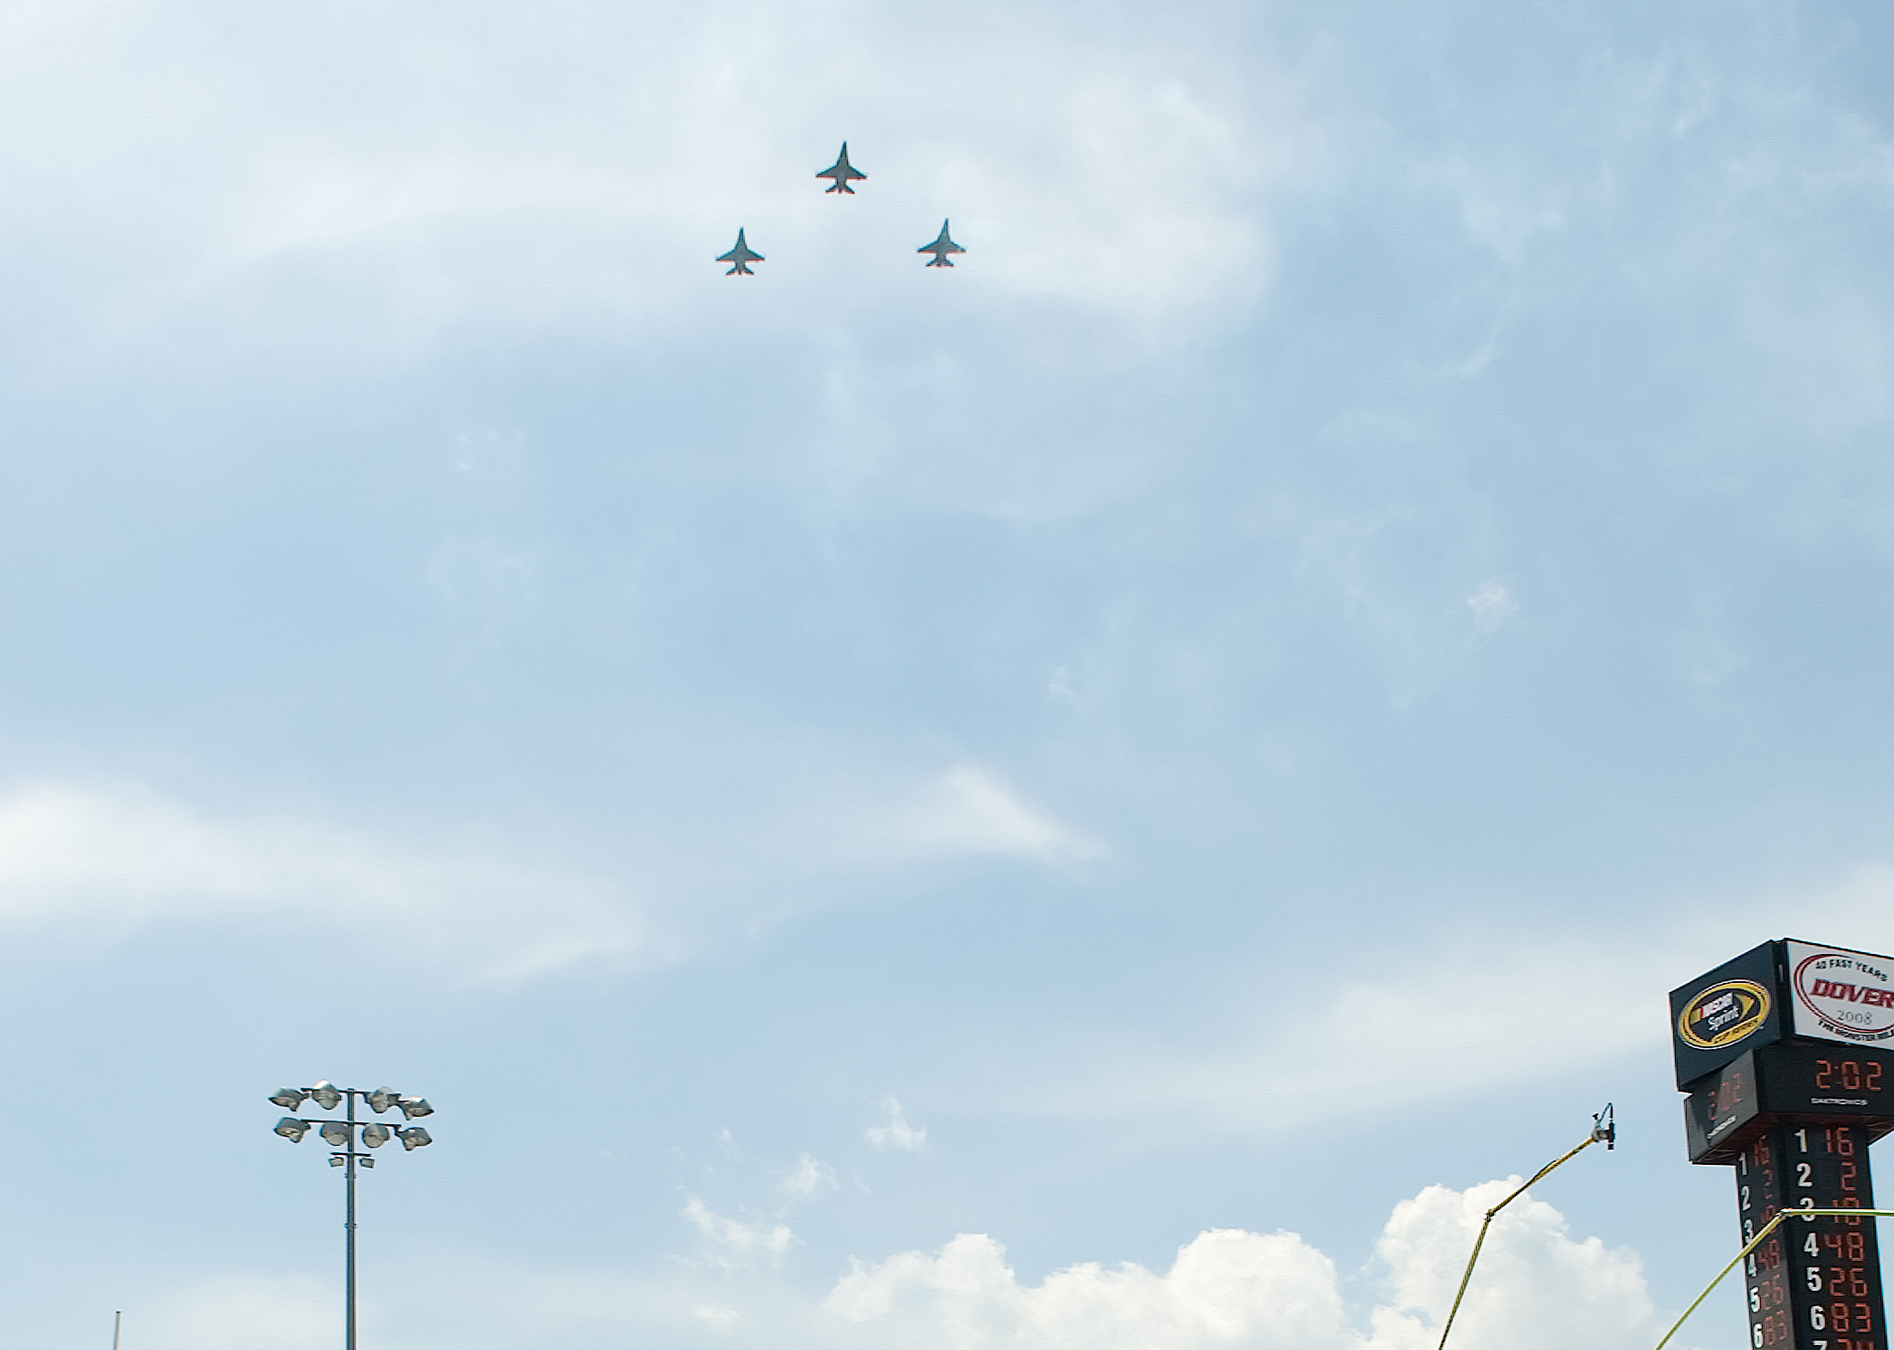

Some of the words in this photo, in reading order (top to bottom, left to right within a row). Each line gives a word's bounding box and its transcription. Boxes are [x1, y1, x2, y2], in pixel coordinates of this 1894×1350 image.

[1829, 959, 1853, 969] FAST
[1855, 961, 1889, 982] YEARS
[1809, 978, 1894, 1009] DOVER
[1708, 1006, 1740, 1031] Sprint
[1836, 1010, 1873, 1026] 2008
[1816, 1060, 1882, 1091] 2:02
[1794, 1129, 1808, 1153] 1
[1826, 1127, 1853, 1156] 16
[1738, 1152, 1748, 1176] 1
[1796, 1163, 1813, 1187] 2
[1841, 1162, 1857, 1190] 2
[1742, 1185, 1751, 1211] 2
[1799, 1197, 1816, 1222] 3
[1804, 1232, 1820, 1257] 4
[1824, 1232, 1865, 1261] 48
[1806, 1267, 1822, 1291] 5
[1829, 1267, 1868, 1296] 26
[1750, 1286, 1761, 1313] 5
[1810, 1305, 1826, 1331] 6
[1831, 1303, 1871, 1332] 83
[1753, 1323, 1764, 1348] 6
